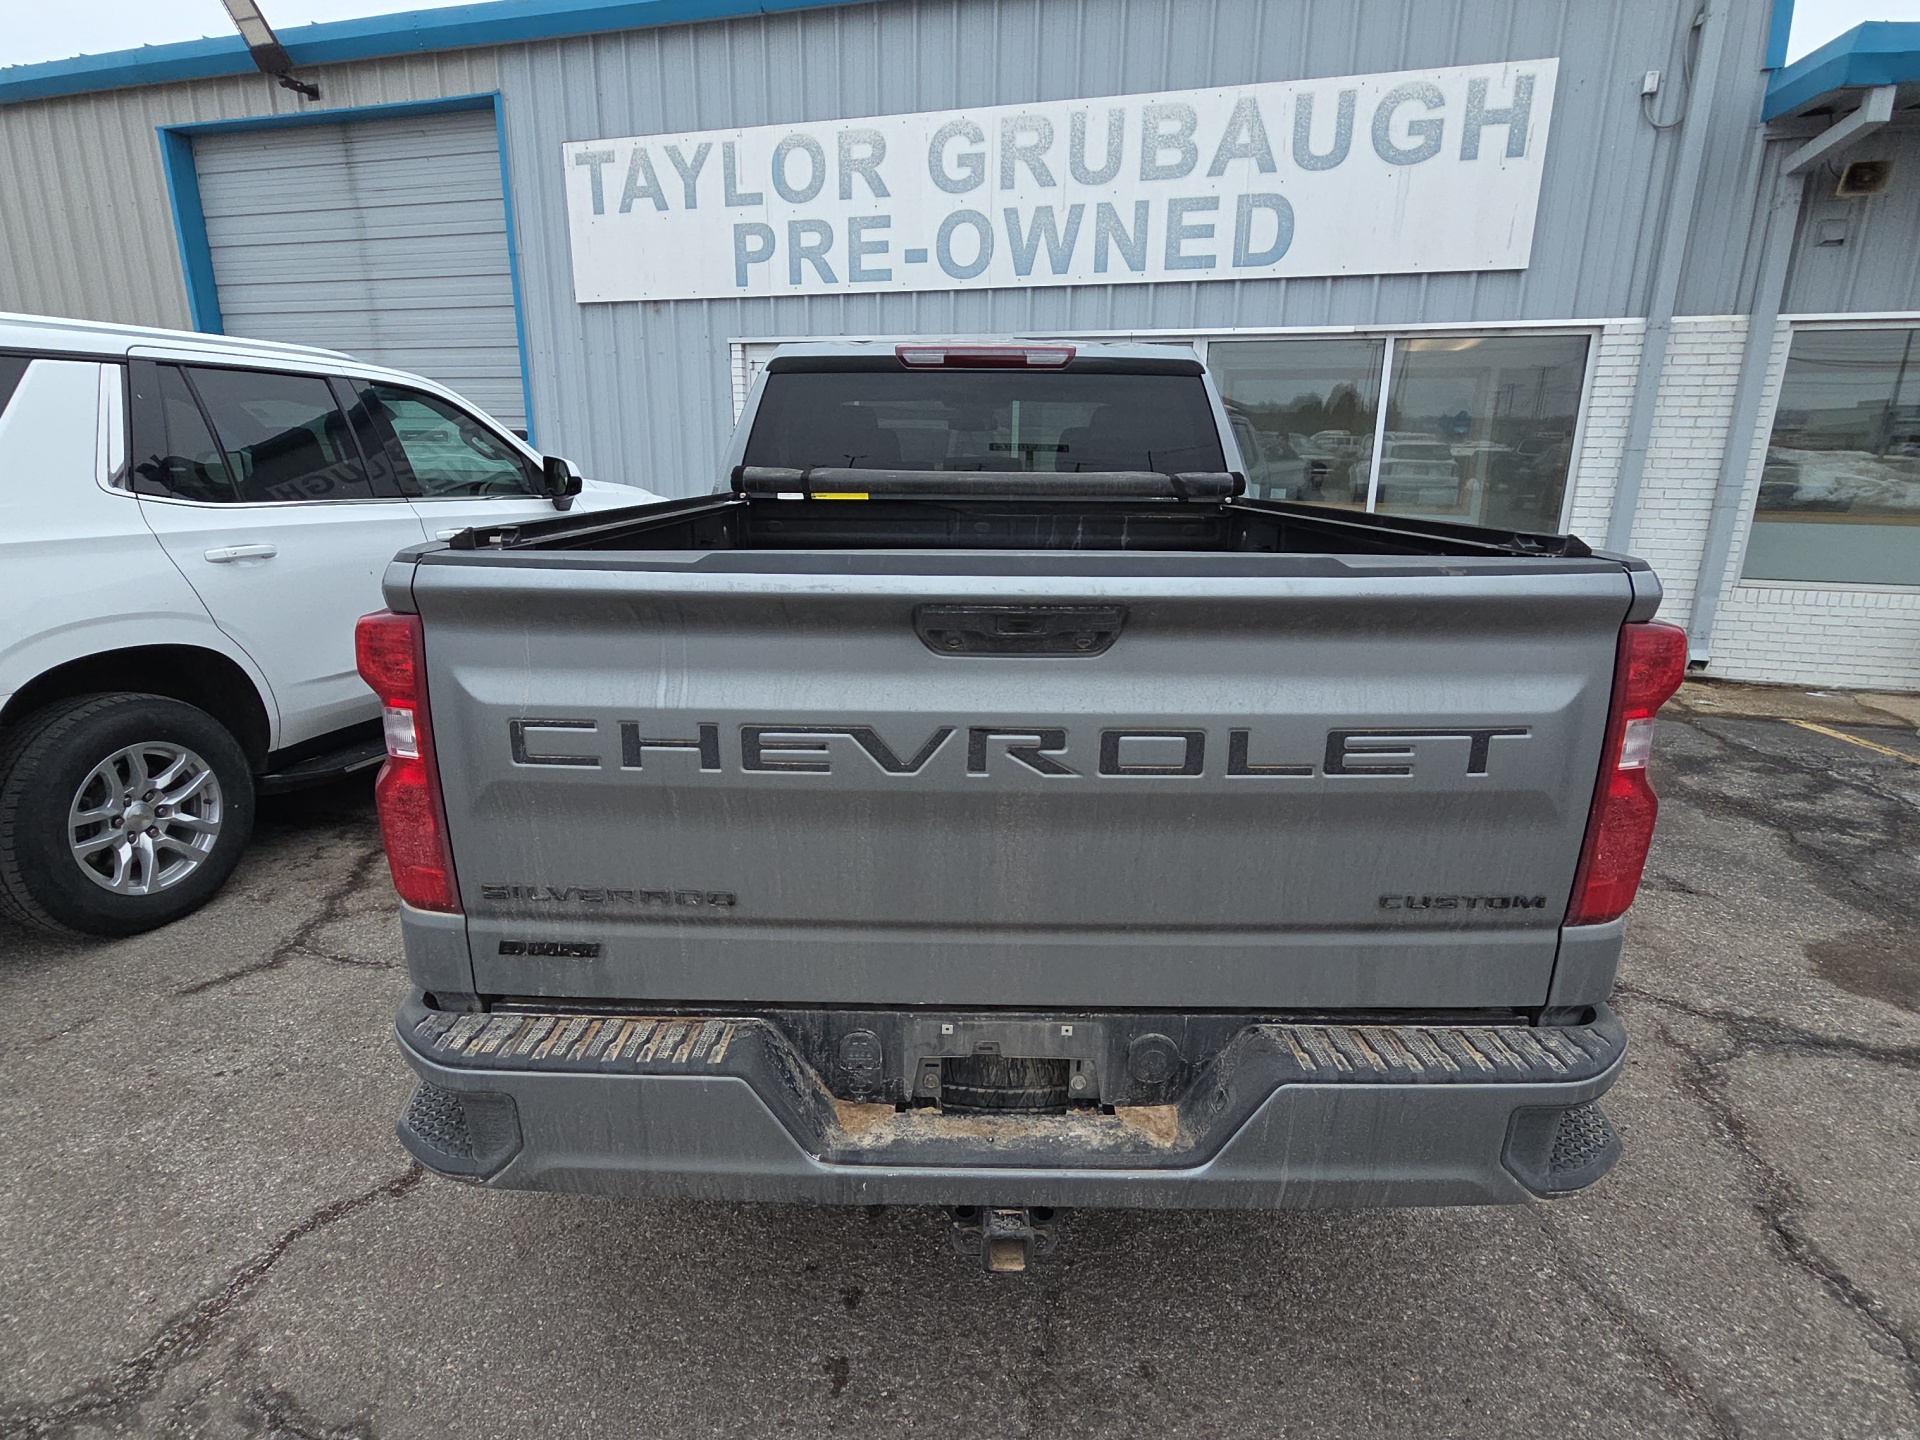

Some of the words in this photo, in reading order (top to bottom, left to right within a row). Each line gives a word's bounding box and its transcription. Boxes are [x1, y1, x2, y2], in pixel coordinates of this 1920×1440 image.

[575, 127, 892, 217] TAYLOR
[927, 73, 1537, 194] GRUBAUGH
[732, 192, 1296, 288] PRE-OWNED
[509, 719, 1533, 779] CHEVROLET
[481, 883, 737, 907] SILVERADO
[1379, 894, 1547, 910] CUSTOM
